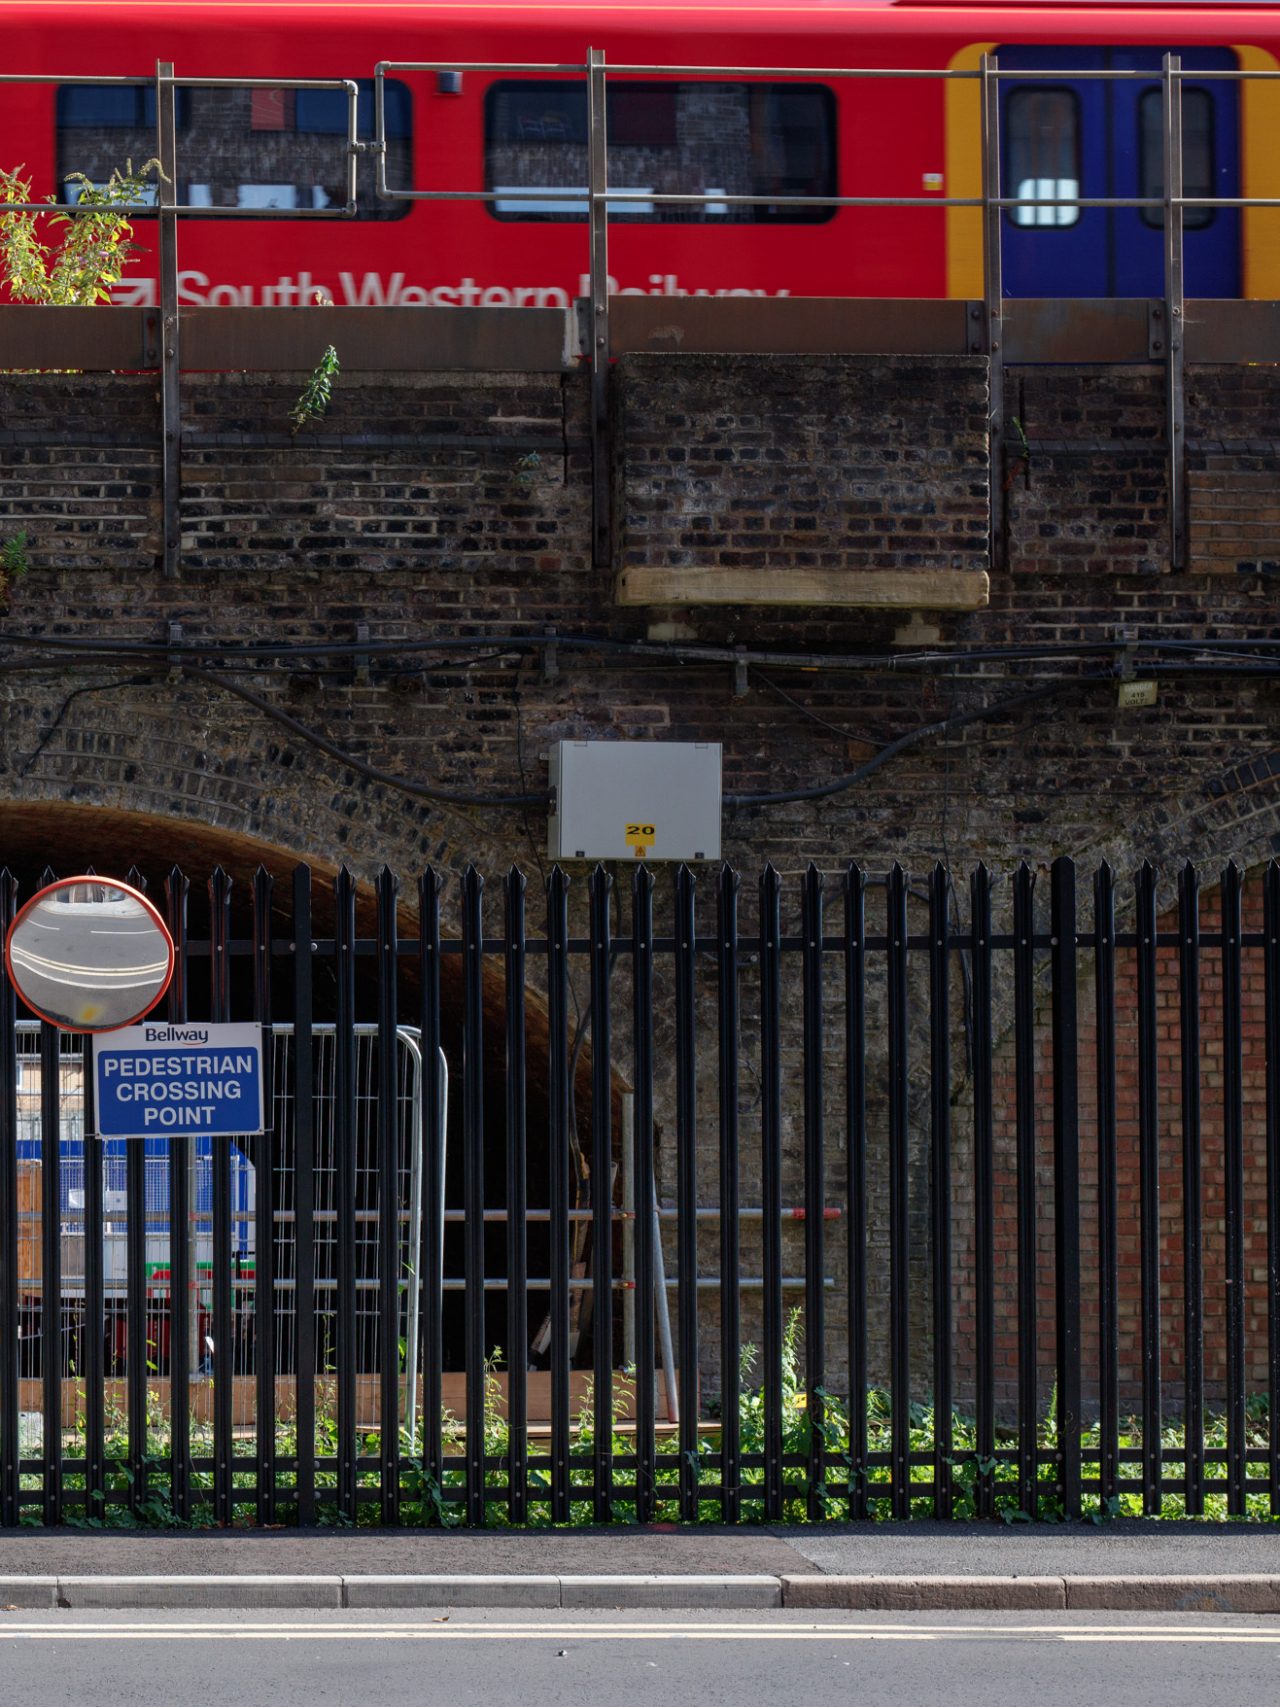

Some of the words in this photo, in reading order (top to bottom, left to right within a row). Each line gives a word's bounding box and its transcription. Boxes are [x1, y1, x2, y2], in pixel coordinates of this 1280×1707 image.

[627, 826, 655, 835] 20
[145, 1027, 208, 1044] Bellway
[104, 1055, 252, 1077] PEDESTRIAN
[116, 1080, 241, 1101] CROSSING
[144, 1106, 216, 1126] POINT
